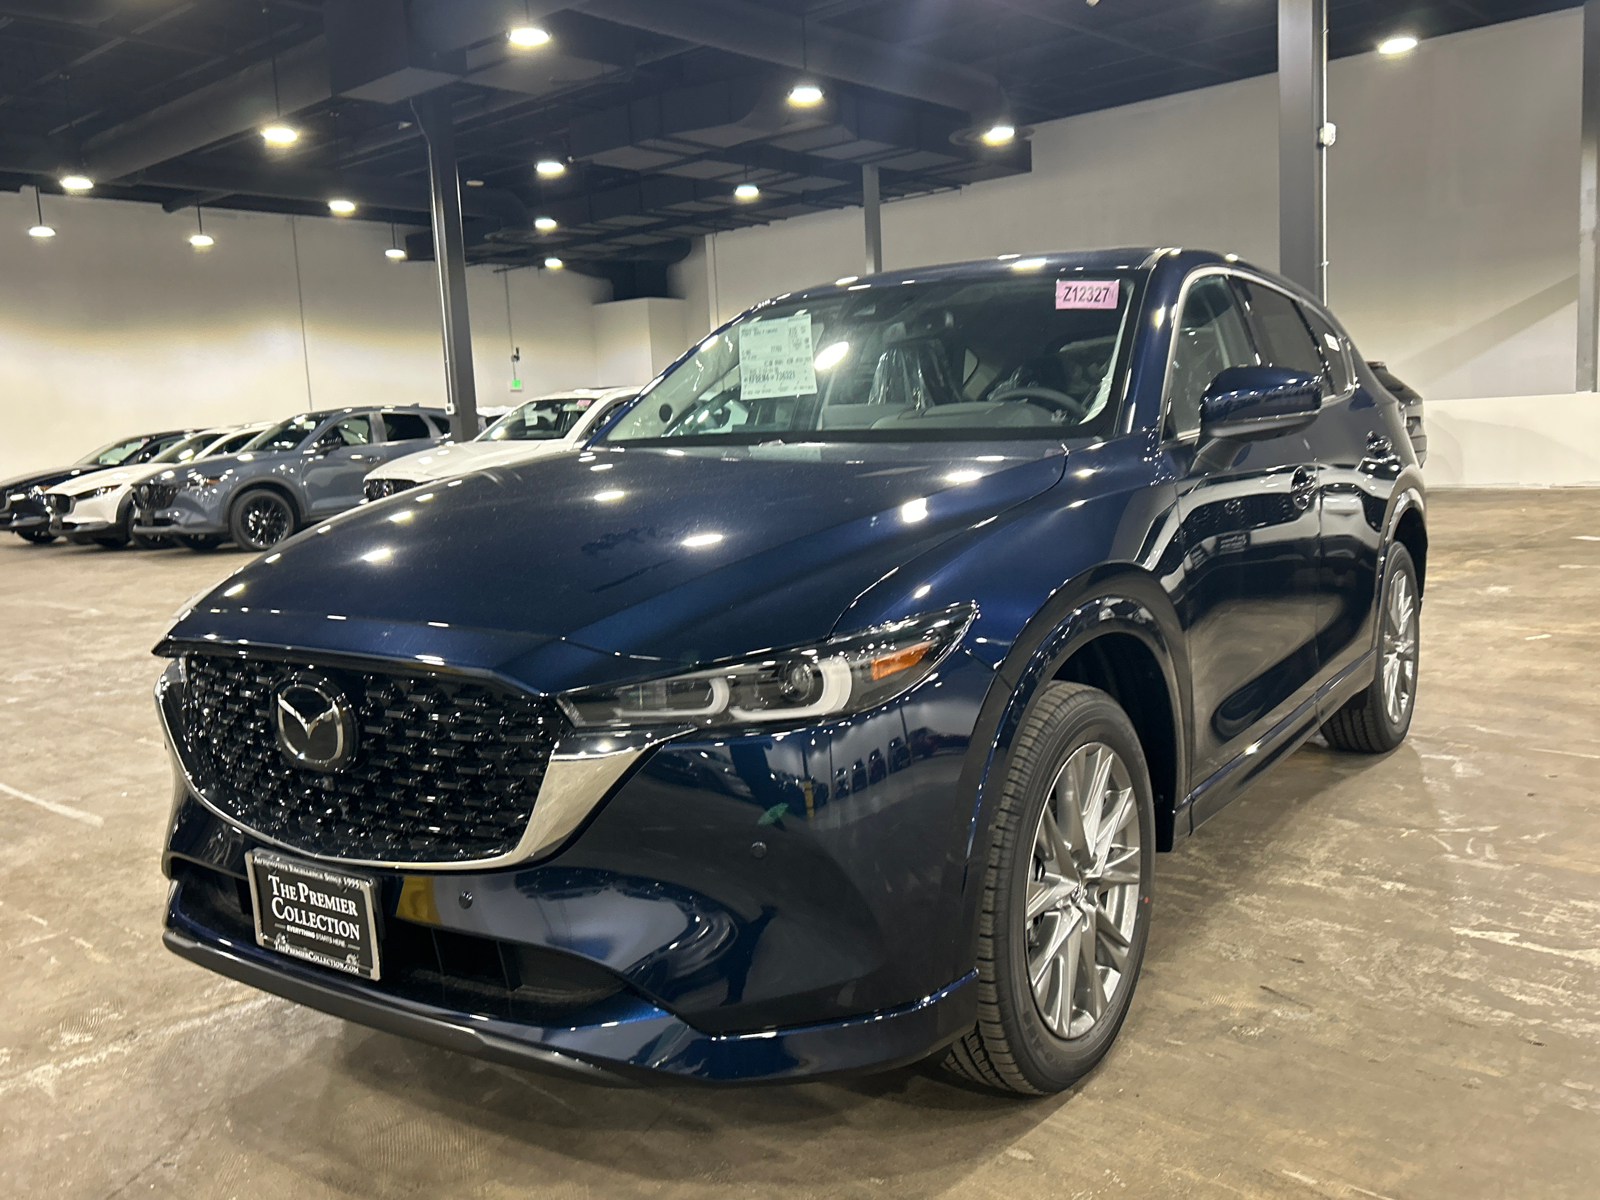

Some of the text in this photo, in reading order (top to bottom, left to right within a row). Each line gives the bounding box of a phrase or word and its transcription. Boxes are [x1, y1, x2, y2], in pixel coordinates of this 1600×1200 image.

[1063, 285, 1110, 303] Z12327
[268, 874, 359, 917] THE PREMIER
[271, 896, 360, 941] COLLECTION
[286, 924, 316, 939] EVERYTHING
